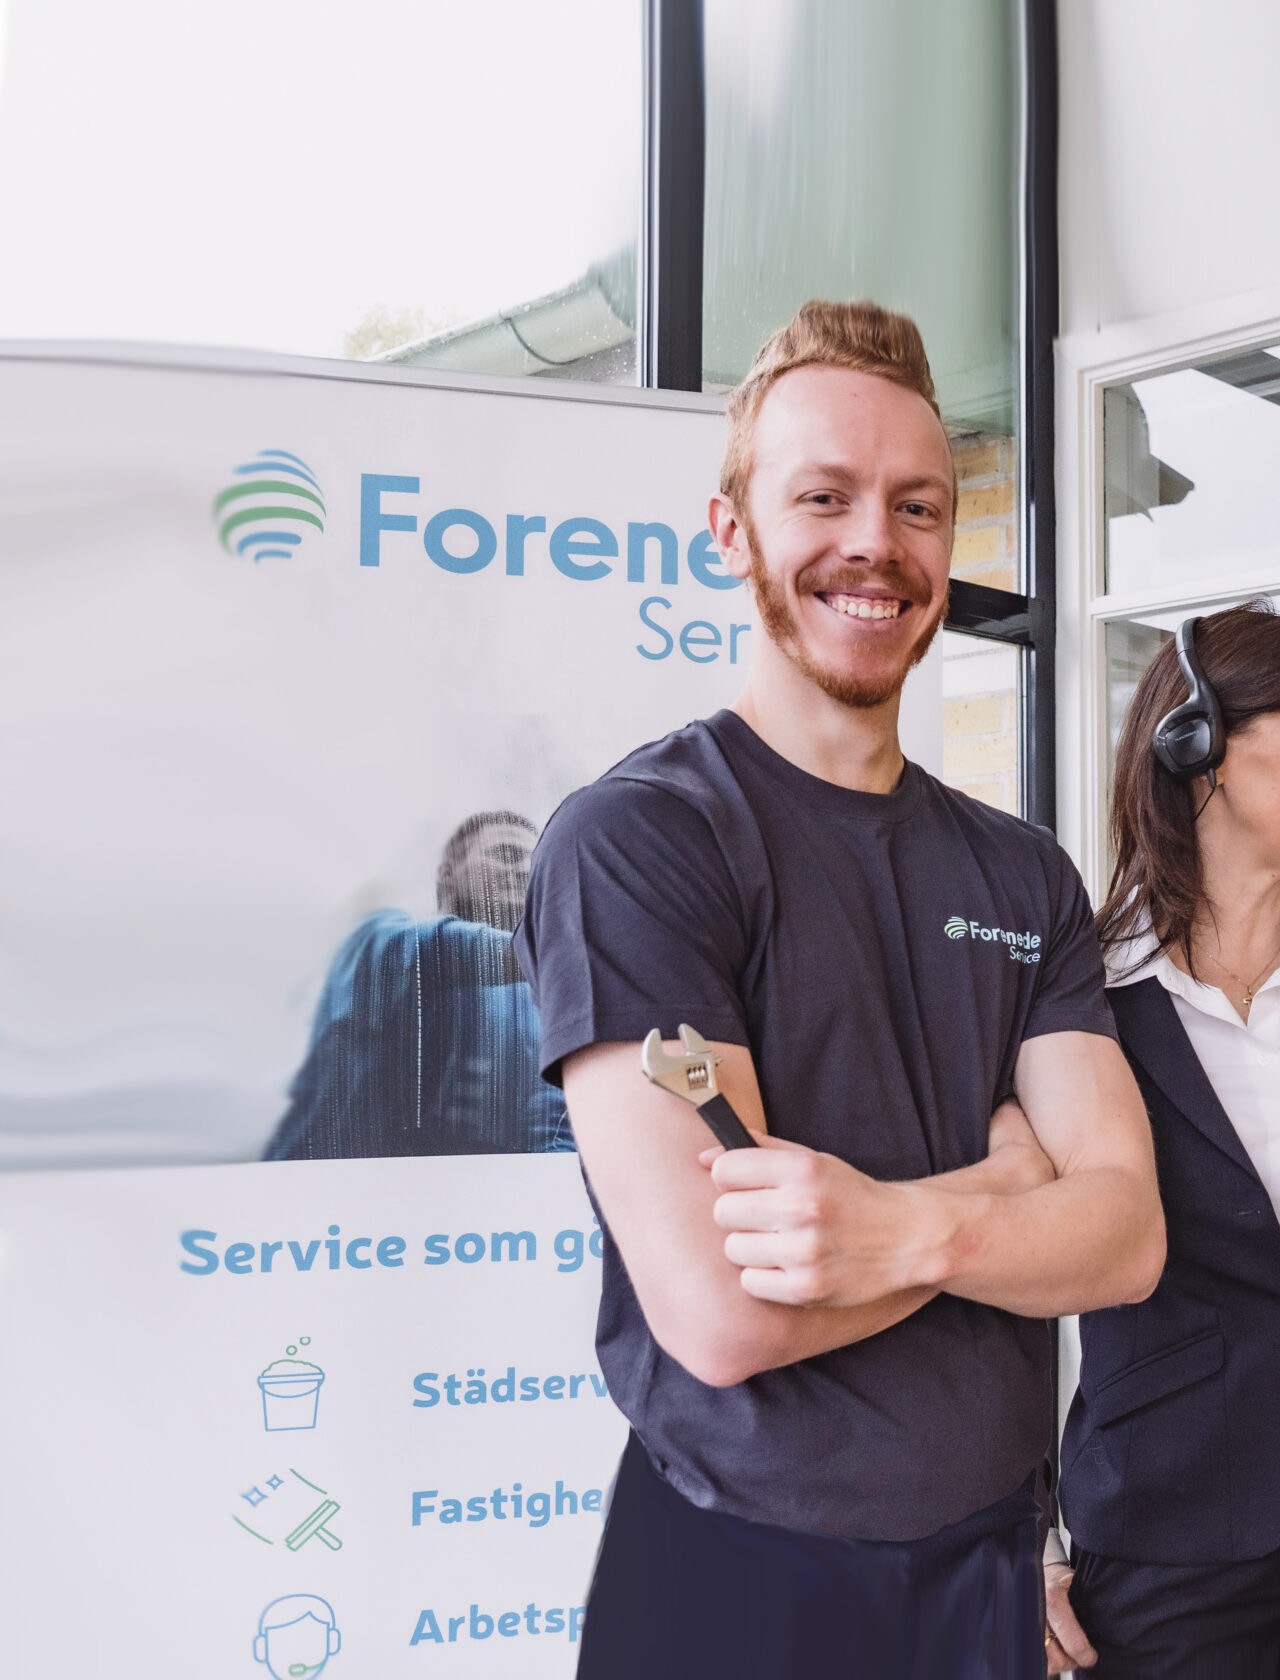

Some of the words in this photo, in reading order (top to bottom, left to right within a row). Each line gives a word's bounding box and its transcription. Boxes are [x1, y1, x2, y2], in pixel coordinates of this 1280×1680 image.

[359, 472, 743, 590] Forene
[636, 596, 752, 664] Ser
[969, 920, 1041, 950] Forenede
[178, 1224, 407, 1276] Service
[423, 1230, 538, 1266] som
[411, 1366, 608, 1408] Städserv
[411, 1480, 603, 1528] Fastighe
[409, 1602, 586, 1647] Arbetsp
